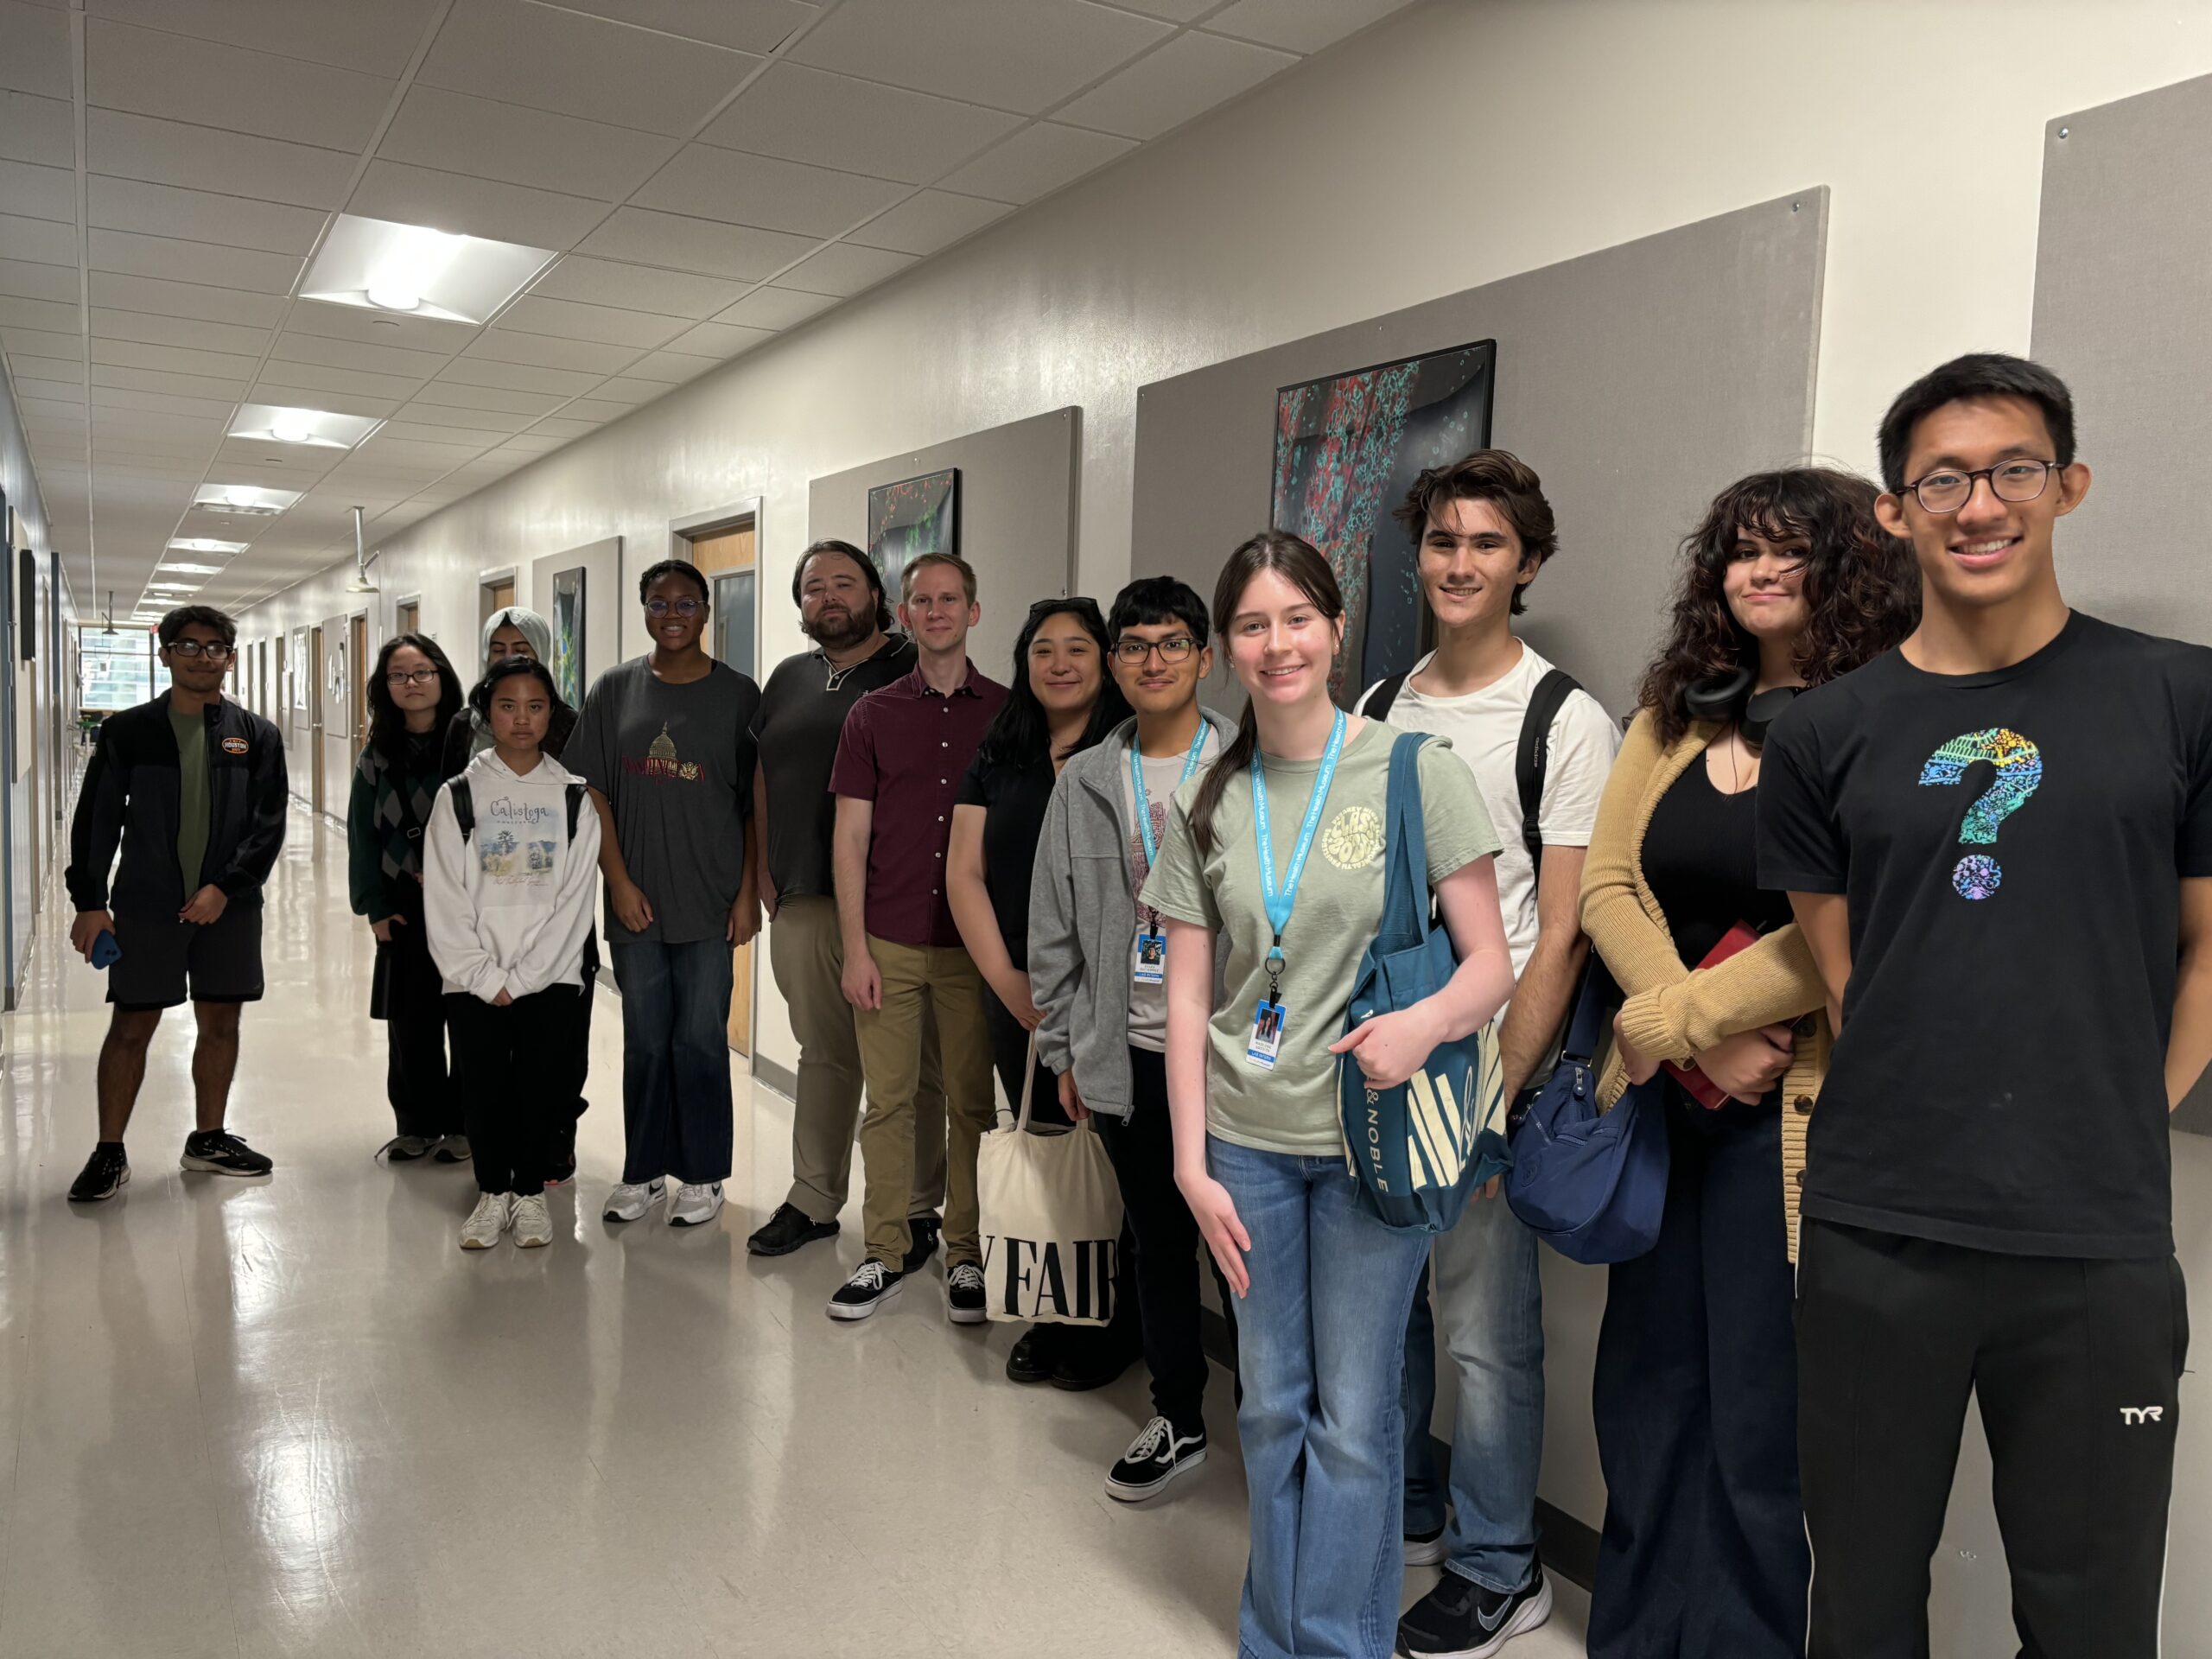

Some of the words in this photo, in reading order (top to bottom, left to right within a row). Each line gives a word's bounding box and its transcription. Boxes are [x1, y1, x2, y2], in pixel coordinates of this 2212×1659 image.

[491, 797, 549, 823] Calistoga
[1332, 812, 1376, 841] CLASS
[1368, 1109, 1389, 1192] NOBLE
[1003, 1236, 1118, 1320] FAIR
[2120, 1406, 2164, 1425] TYR
